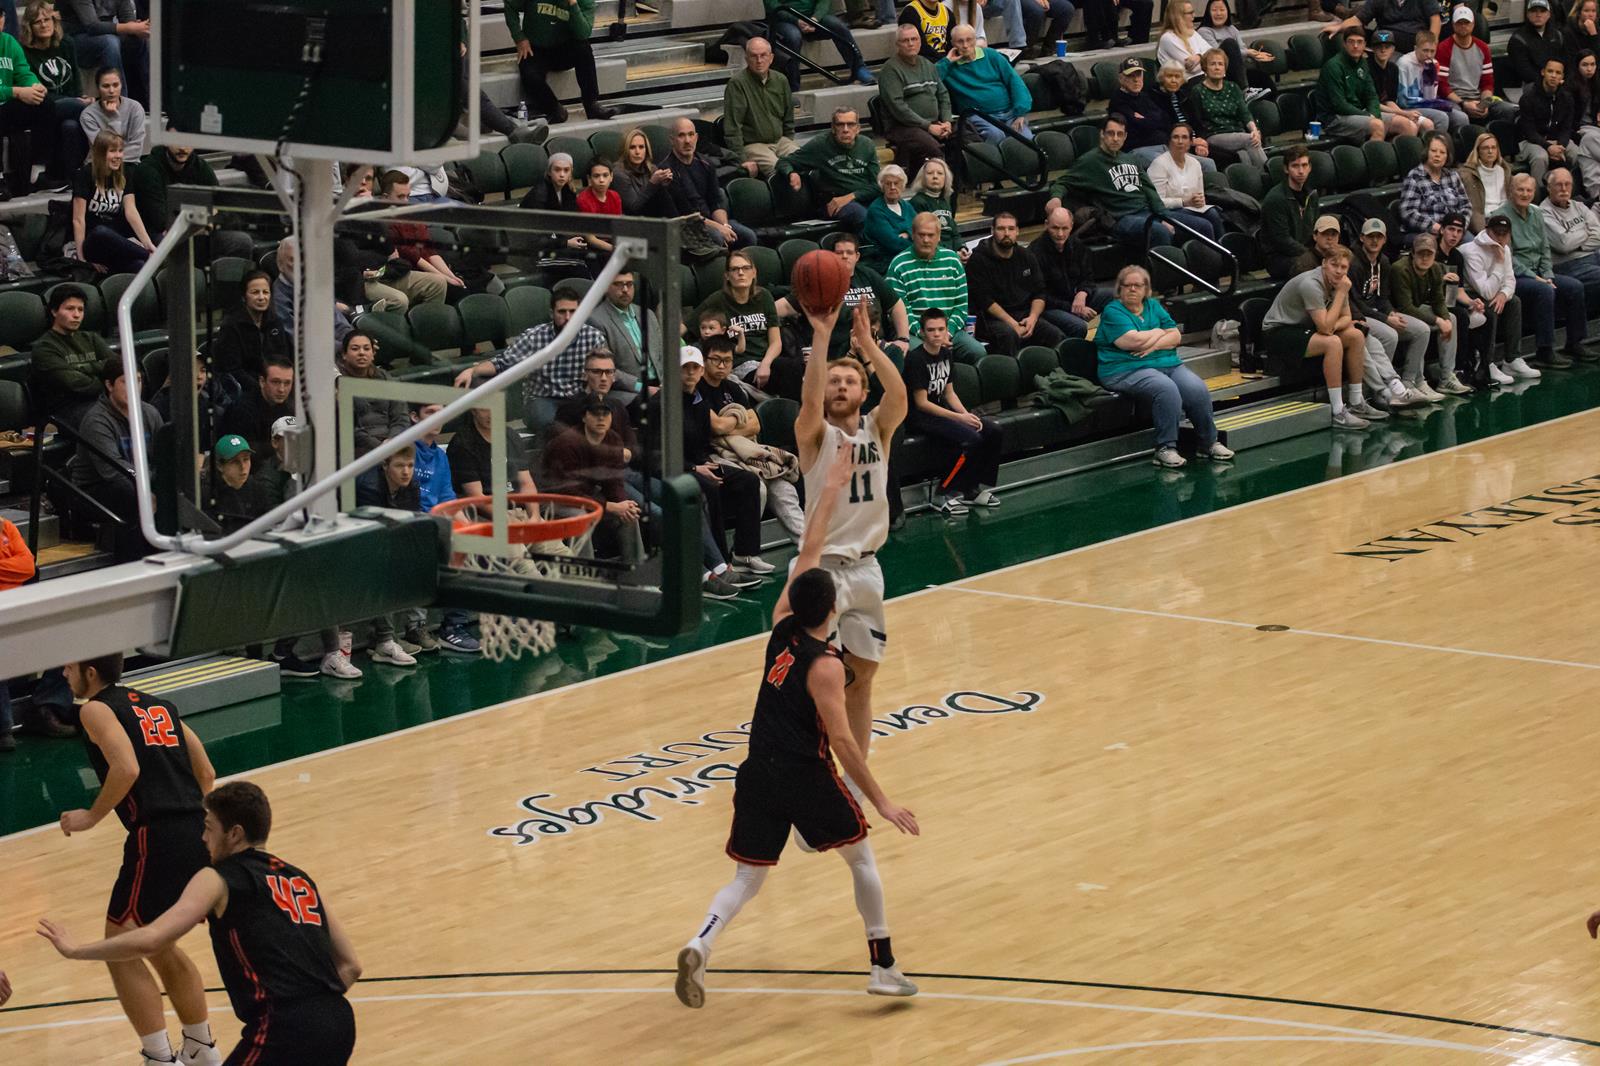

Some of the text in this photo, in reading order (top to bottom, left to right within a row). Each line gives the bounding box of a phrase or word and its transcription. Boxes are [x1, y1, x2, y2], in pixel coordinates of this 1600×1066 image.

[730, 313, 767, 326] ILLINOIS
[849, 470, 874, 504] 11
[131, 705, 179, 747] 22
[577, 722, 752, 782] OURT
[265, 874, 323, 927] 42
